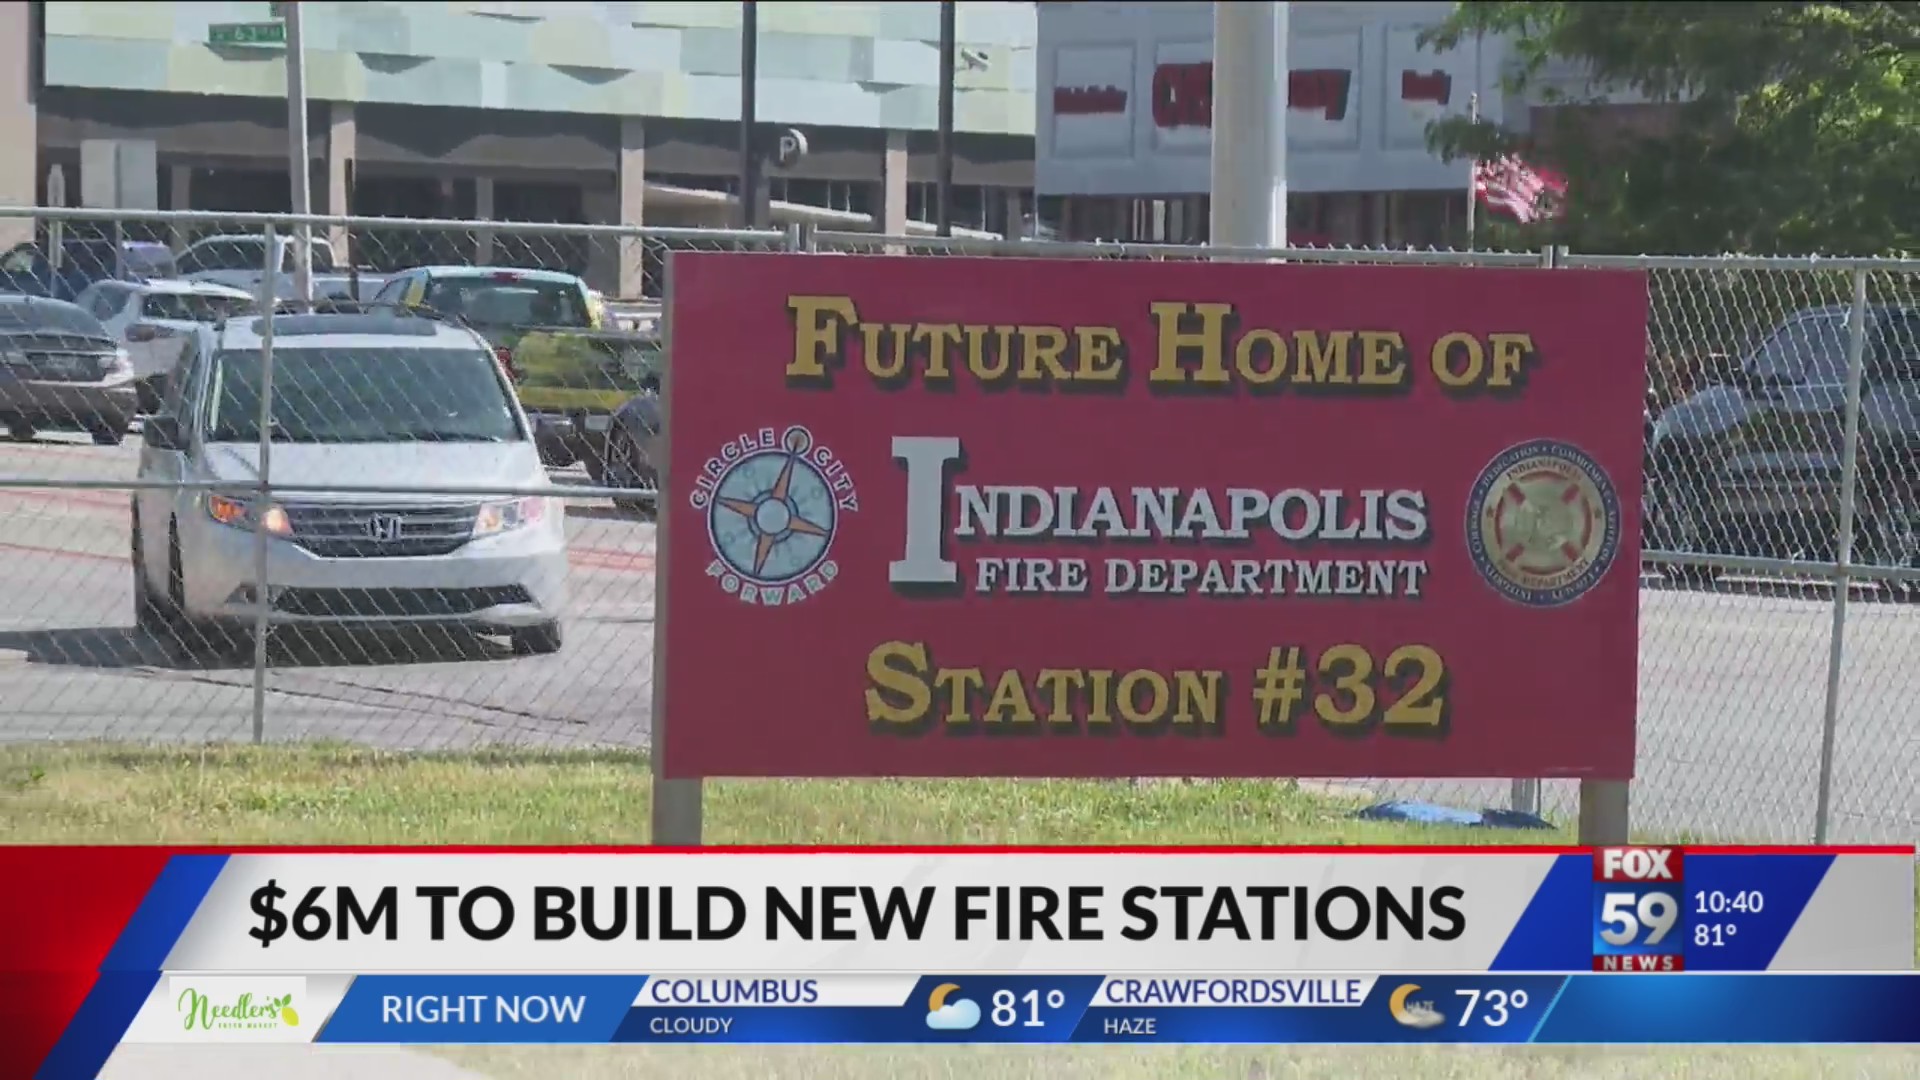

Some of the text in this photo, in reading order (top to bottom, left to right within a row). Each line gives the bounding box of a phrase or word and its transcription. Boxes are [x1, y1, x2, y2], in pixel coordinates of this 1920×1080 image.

[779, 136, 797, 162] P
[785, 294, 1536, 390] FUTURE HOME OF
[690, 428, 858, 512] CIRCLE CITY
[889, 436, 1430, 583] INDIANAPOLIS
[705, 559, 839, 606] FORWARD
[975, 557, 1428, 596] FIRE DEPARTMENT
[864, 640, 1449, 728] STATION #32
